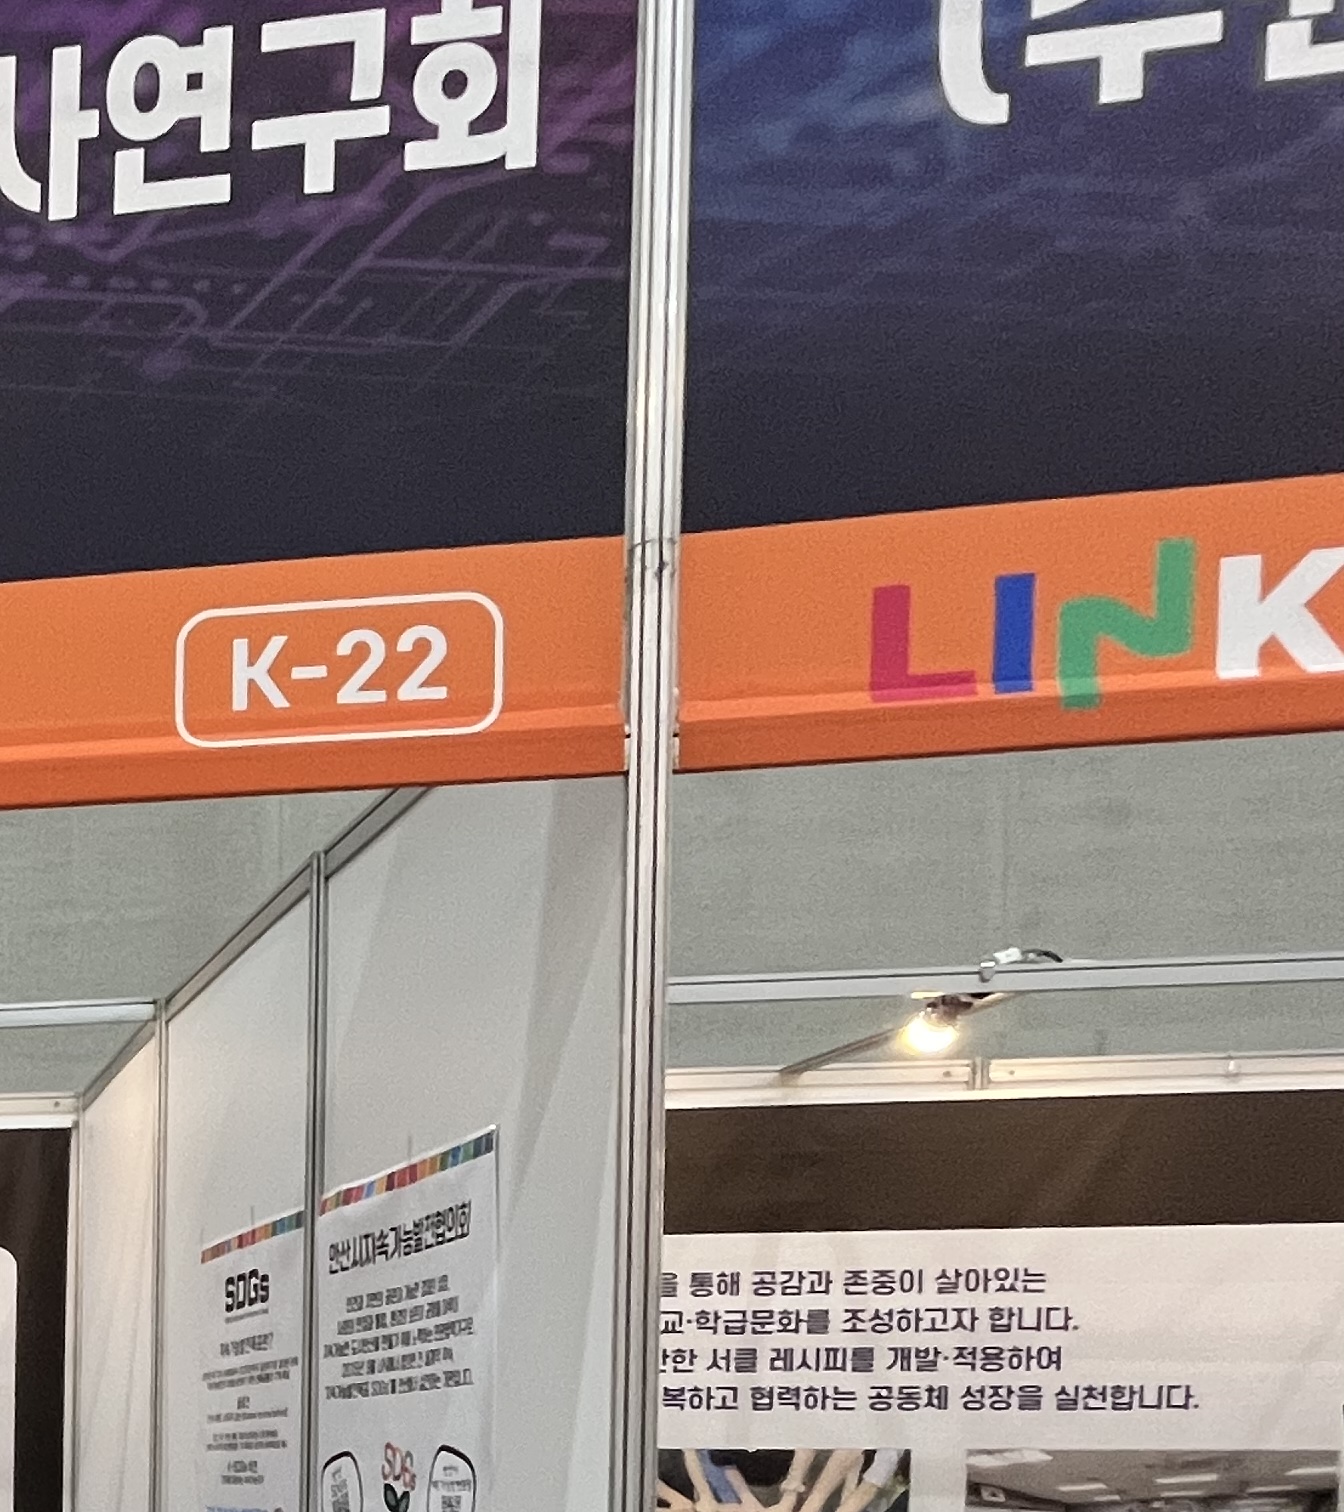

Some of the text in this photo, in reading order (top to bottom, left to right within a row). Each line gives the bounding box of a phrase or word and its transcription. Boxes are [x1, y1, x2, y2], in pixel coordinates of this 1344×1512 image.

[870, 537, 1344, 710] LINK
[230, 625, 450, 713] K-22
[225, 1268, 270, 1313] SDGs
[689, 1271, 741, 1297] 통해
[751, 1270, 833, 1296] 공감과
[843, 1269, 924, 1294] 존중이
[935, 1268, 1047, 1294] 살아있는
[841, 1306, 979, 1333] 조성하고자
[989, 1306, 1080, 1333] 합니다.
[706, 1347, 758, 1373] 서클
[769, 1346, 876, 1372] 레시피를
[662, 1384, 1200, 1412] 복하고 협력하는 공동체 성장을 실천합니다.
